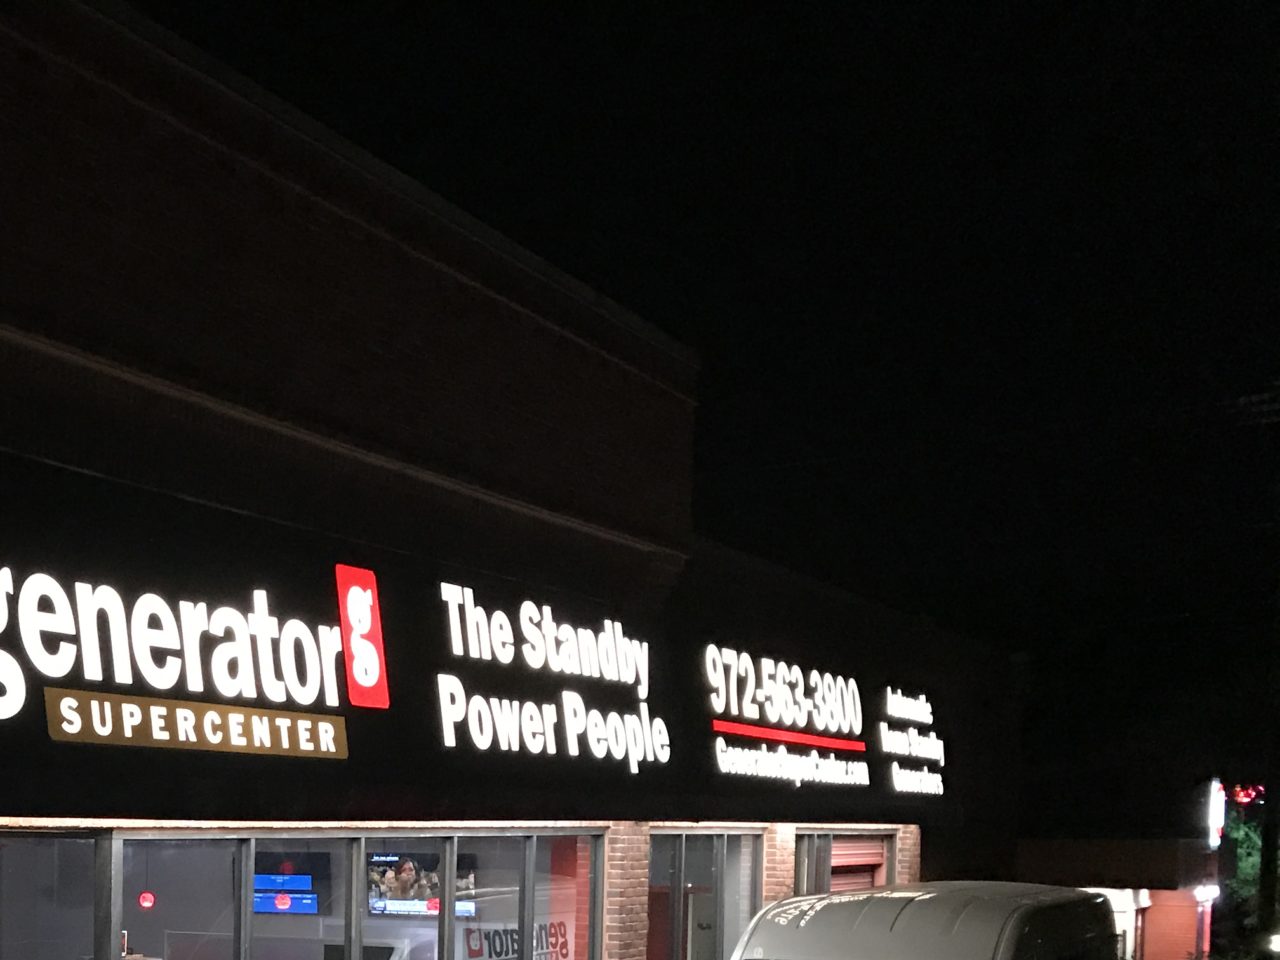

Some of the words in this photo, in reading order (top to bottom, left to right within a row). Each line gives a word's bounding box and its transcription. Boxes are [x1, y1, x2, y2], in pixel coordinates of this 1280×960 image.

[347, 585, 380, 687] g
[441, 582, 515, 664] The
[520, 600, 648, 699] Standby
[61, 697, 337, 753] SUPERCENTER
[437, 673, 557, 754] Power
[562, 691, 670, 774] People
[705, 644, 863, 735] 972-563-3800
